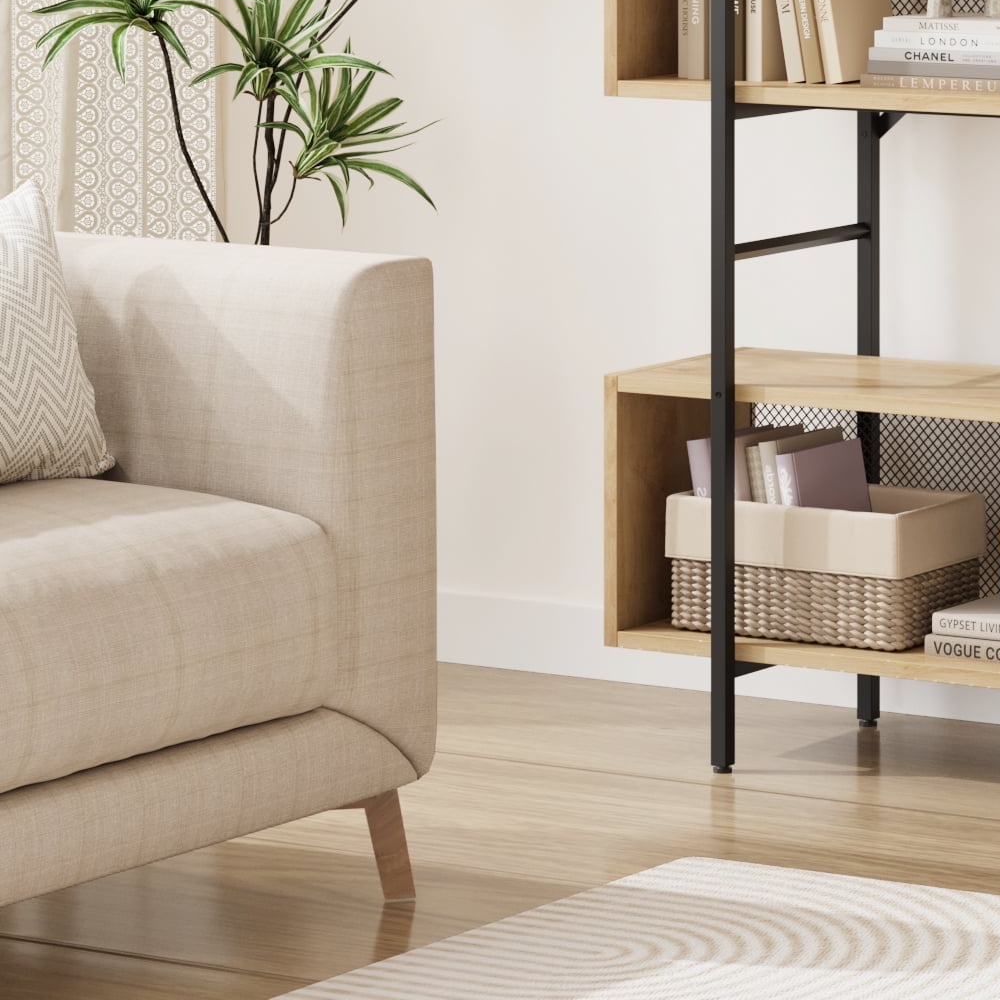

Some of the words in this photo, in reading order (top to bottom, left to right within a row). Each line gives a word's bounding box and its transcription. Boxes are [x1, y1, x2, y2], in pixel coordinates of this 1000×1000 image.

[800, 14, 811, 40] DESIGN
[918, 22, 960, 32] MATISSE
[920, 38, 979, 48] LONDON
[904, 52, 955, 62] CHANEL
[939, 618, 976, 631] GYPSET
[933, 641, 981, 659] VOGUE
